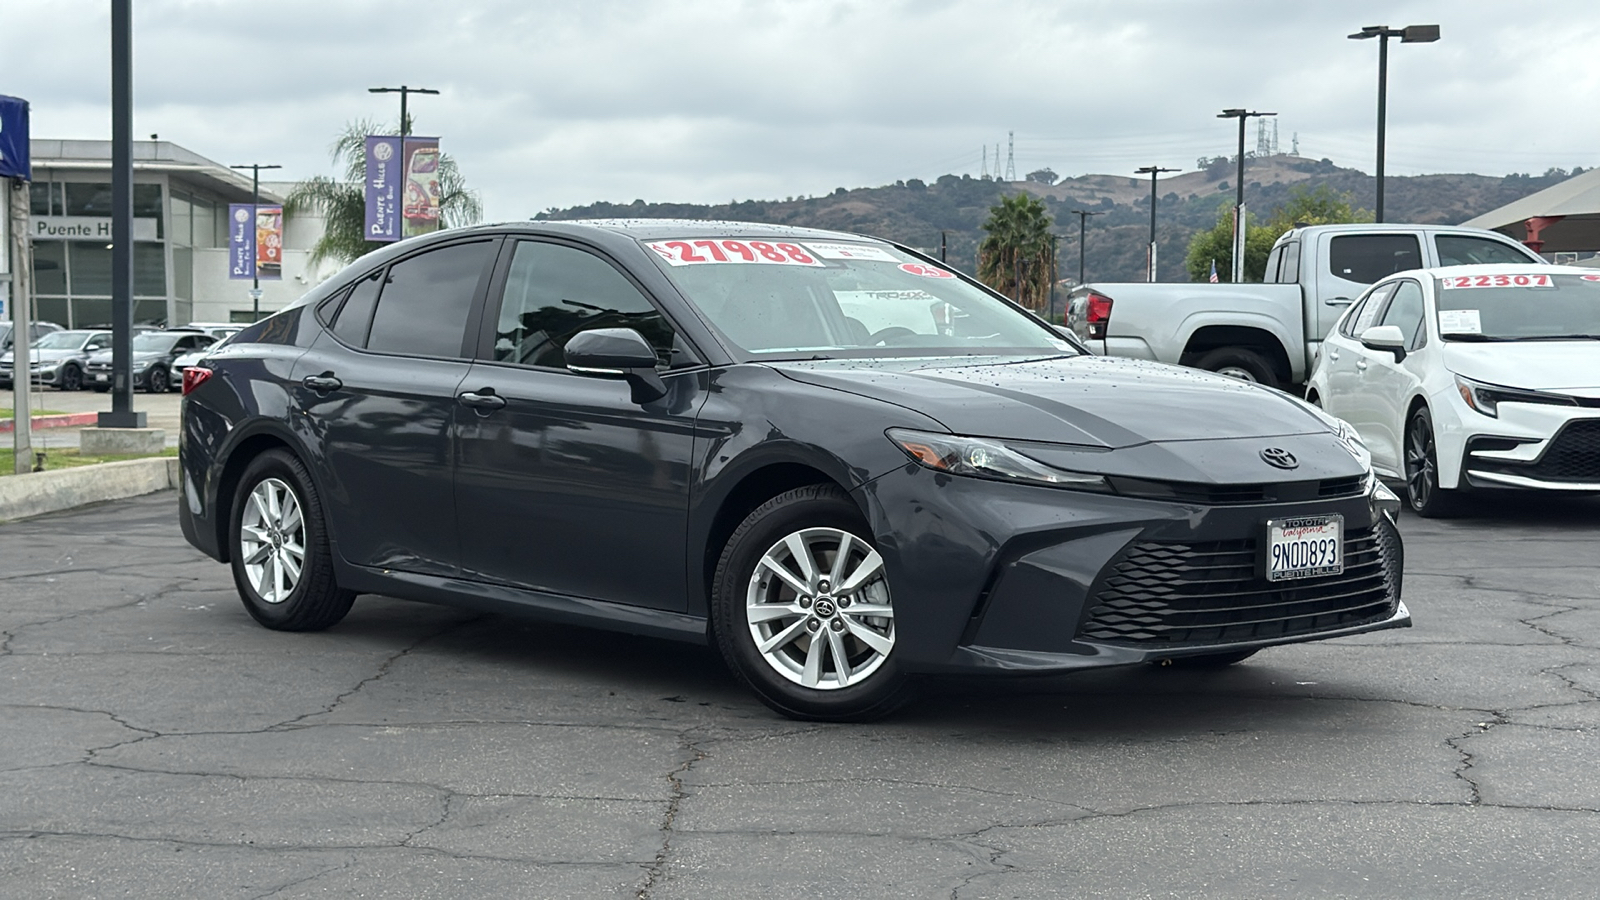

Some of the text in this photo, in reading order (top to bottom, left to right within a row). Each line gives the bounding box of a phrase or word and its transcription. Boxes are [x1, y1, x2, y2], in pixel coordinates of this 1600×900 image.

[37, 222, 91, 236] Puente
[1287, 518, 1325, 528] TOYOTA
[1282, 526, 1327, 540] California
